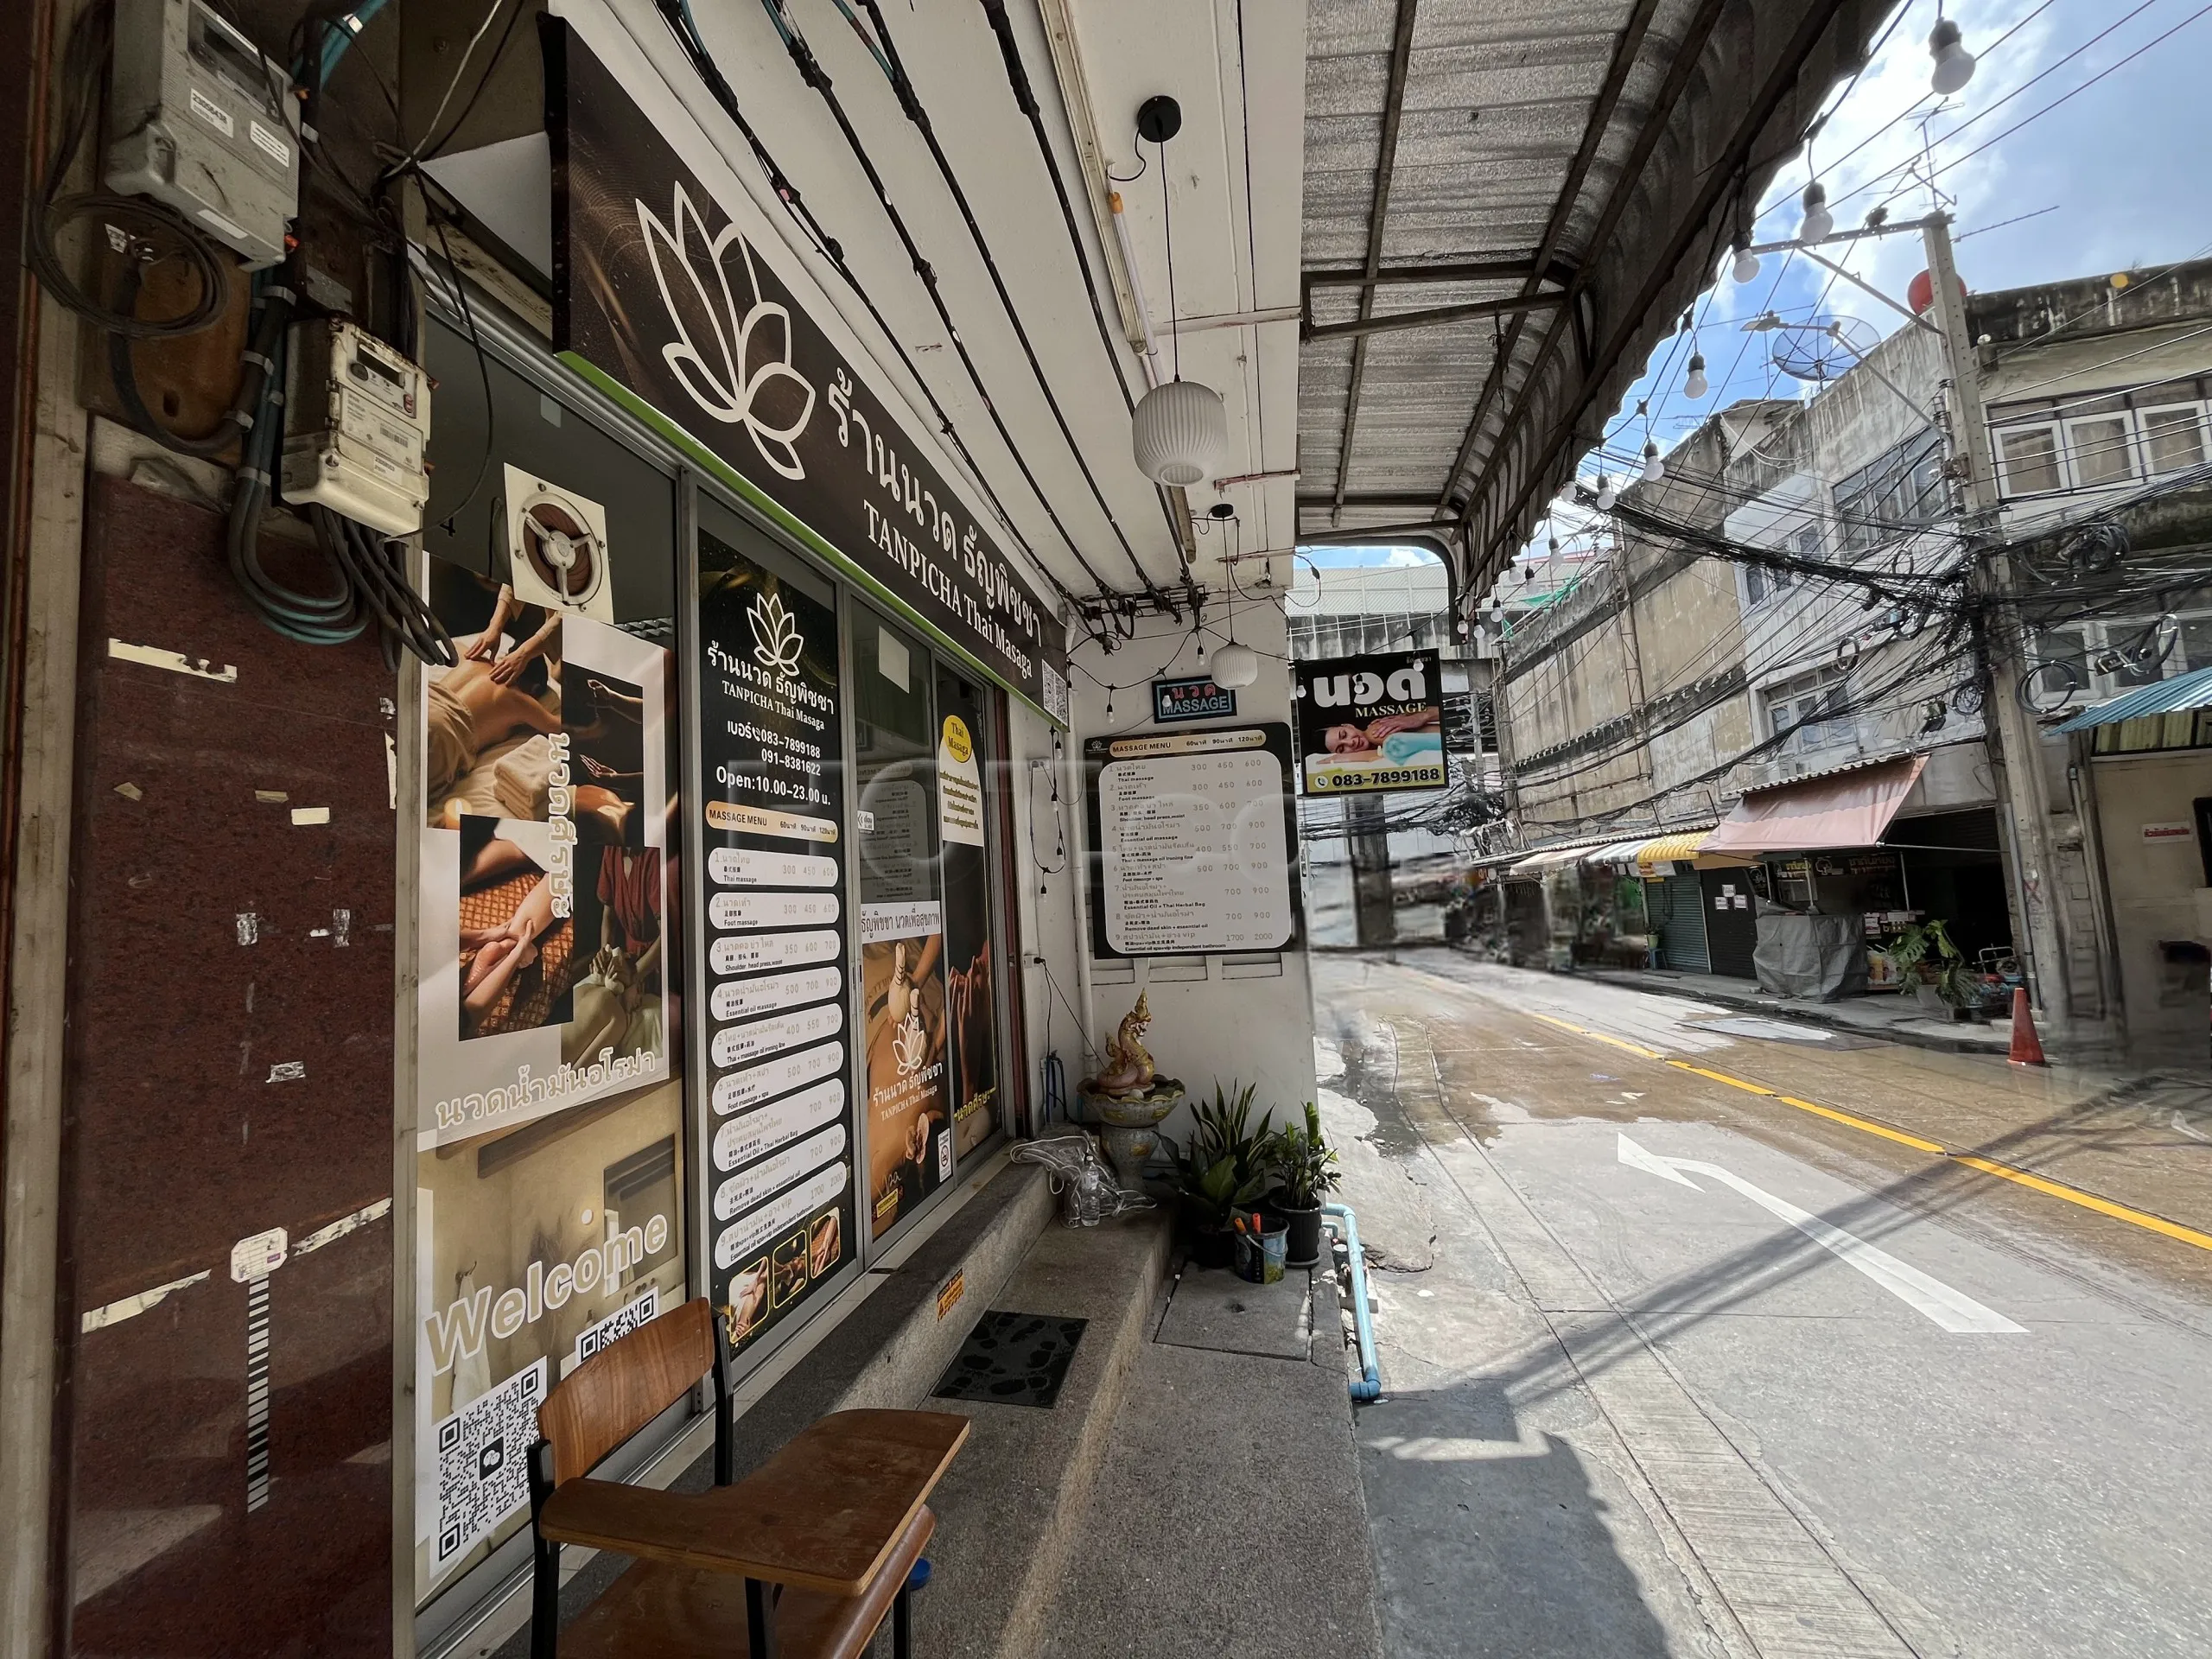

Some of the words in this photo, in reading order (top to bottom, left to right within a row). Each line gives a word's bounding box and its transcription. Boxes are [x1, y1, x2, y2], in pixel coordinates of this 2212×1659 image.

[828, 366, 957, 560] ร้านนวด
[963, 524, 1042, 647] ธัญพิชชา
[864, 499, 963, 617] TANPICHA
[963, 595, 993, 643] Thai
[995, 627, 1033, 677] Masaga
[708, 640, 771, 689] ร้านนวด
[776, 672, 834, 714] ธัญพิชชา
[1313, 669, 1426, 707] นวด
[1172, 684, 1216, 699] นวด
[722, 680, 773, 710] TANPICHA
[775, 701, 794, 719] Thai
[797, 710, 824, 731] Masaga
[1163, 696, 1228, 714] MASSAGE
[1355, 702, 1427, 717] MASSAGE
[728, 721, 752, 739] เบอร์
[761, 729, 820, 758] 083-7899188
[951, 722, 964, 738] Thai
[948, 736, 969, 756] Masaga
[761, 748, 821, 776] 091-8381622
[1332, 768, 1440, 786] 083-7899188
[549, 733, 577, 918] นวดศีรษะ
[709, 810, 747, 823] MASSAGE
[747, 816, 767, 826] MENU
[783, 865, 796, 874] 300
[804, 866, 816, 874] 450
[823, 868, 834, 876] 600
[785, 905, 797, 914] 300
[804, 904, 816, 912] 450
[824, 904, 835, 912] 600
[861, 911, 893, 938] ธัญพิชชา
[895, 904, 940, 932] นวดเพื่อสุขภาพ
[785, 945, 798, 954] 350
[805, 942, 817, 952] 600
[825, 940, 836, 950] 700
[785, 985, 798, 995] 500
[806, 981, 819, 990] 700
[826, 977, 836, 987] 900
[726, 1006, 749, 1018] Essential
[757, 1002, 778, 1011] massage
[786, 1024, 800, 1035] 400
[807, 1020, 819, 1030] 550
[827, 1014, 838, 1026] 700
[788, 1065, 800, 1077] 500
[809, 1058, 821, 1070] 700
[828, 1052, 839, 1063] 900
[435, 1047, 656, 1129] นวดน้ำมันอโรม่า
[873, 1080, 907, 1107] ร้านนวด
[909, 1063, 942, 1090] ธัญพิชชา
[809, 1101, 822, 1114] 700
[830, 1092, 840, 1104] 900
[881, 1101, 909, 1122] TANPICHA
[909, 1091, 919, 1103] Thai
[921, 1085, 938, 1099] Masaga
[728, 1153, 752, 1167] Essential
[764, 1141, 774, 1151] Thai
[775, 1134, 789, 1144] Herbal
[790, 1130, 798, 1139] Bag
[810, 1145, 823, 1158] 700
[830, 1135, 842, 1147] 900
[729, 1200, 750, 1215] Remove
[750, 1192, 762, 1203] dead
[762, 1187, 772, 1198] skin
[782, 1198, 791, 1208] vip
[810, 1184, 824, 1199] 1700
[830, 1172, 843, 1187] 2000
[425, 1214, 668, 1376] Welcome
